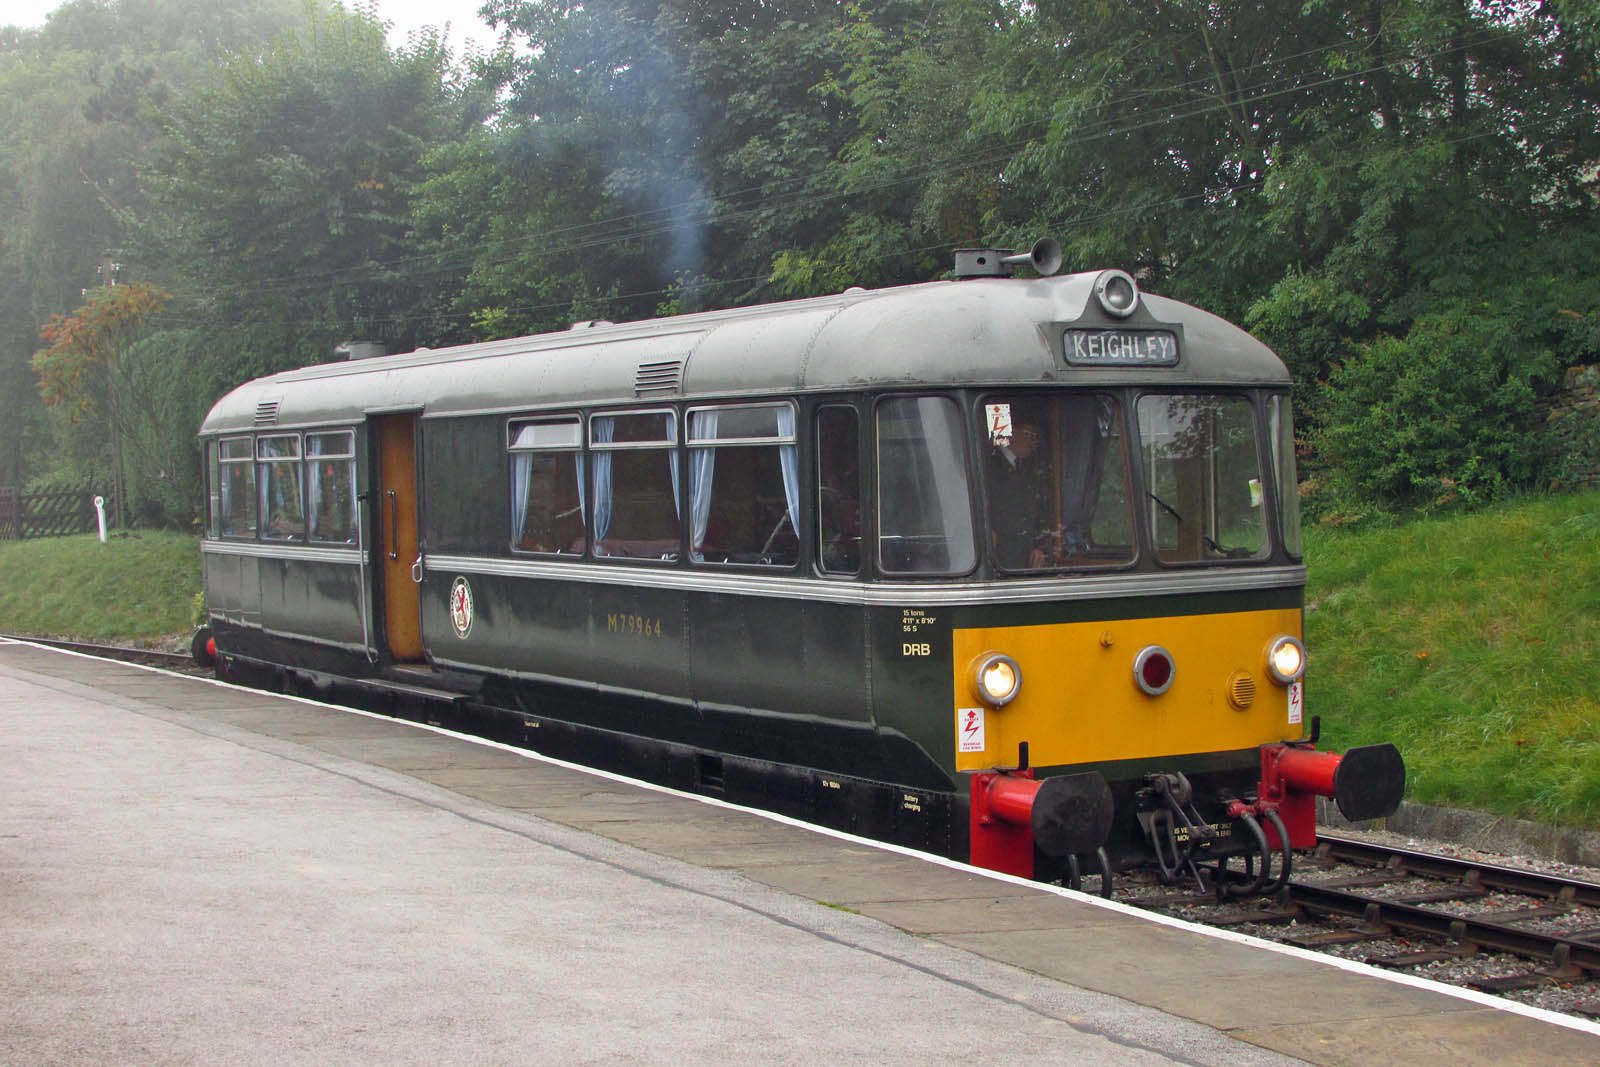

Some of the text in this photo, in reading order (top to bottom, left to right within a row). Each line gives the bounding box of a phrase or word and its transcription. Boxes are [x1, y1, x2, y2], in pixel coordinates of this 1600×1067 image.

[1073, 334, 1170, 360] KEIGHLEY
[903, 609, 925, 617] 15 tons
[607, 613, 661, 638] M79964
[903, 643, 931, 656] DRB
